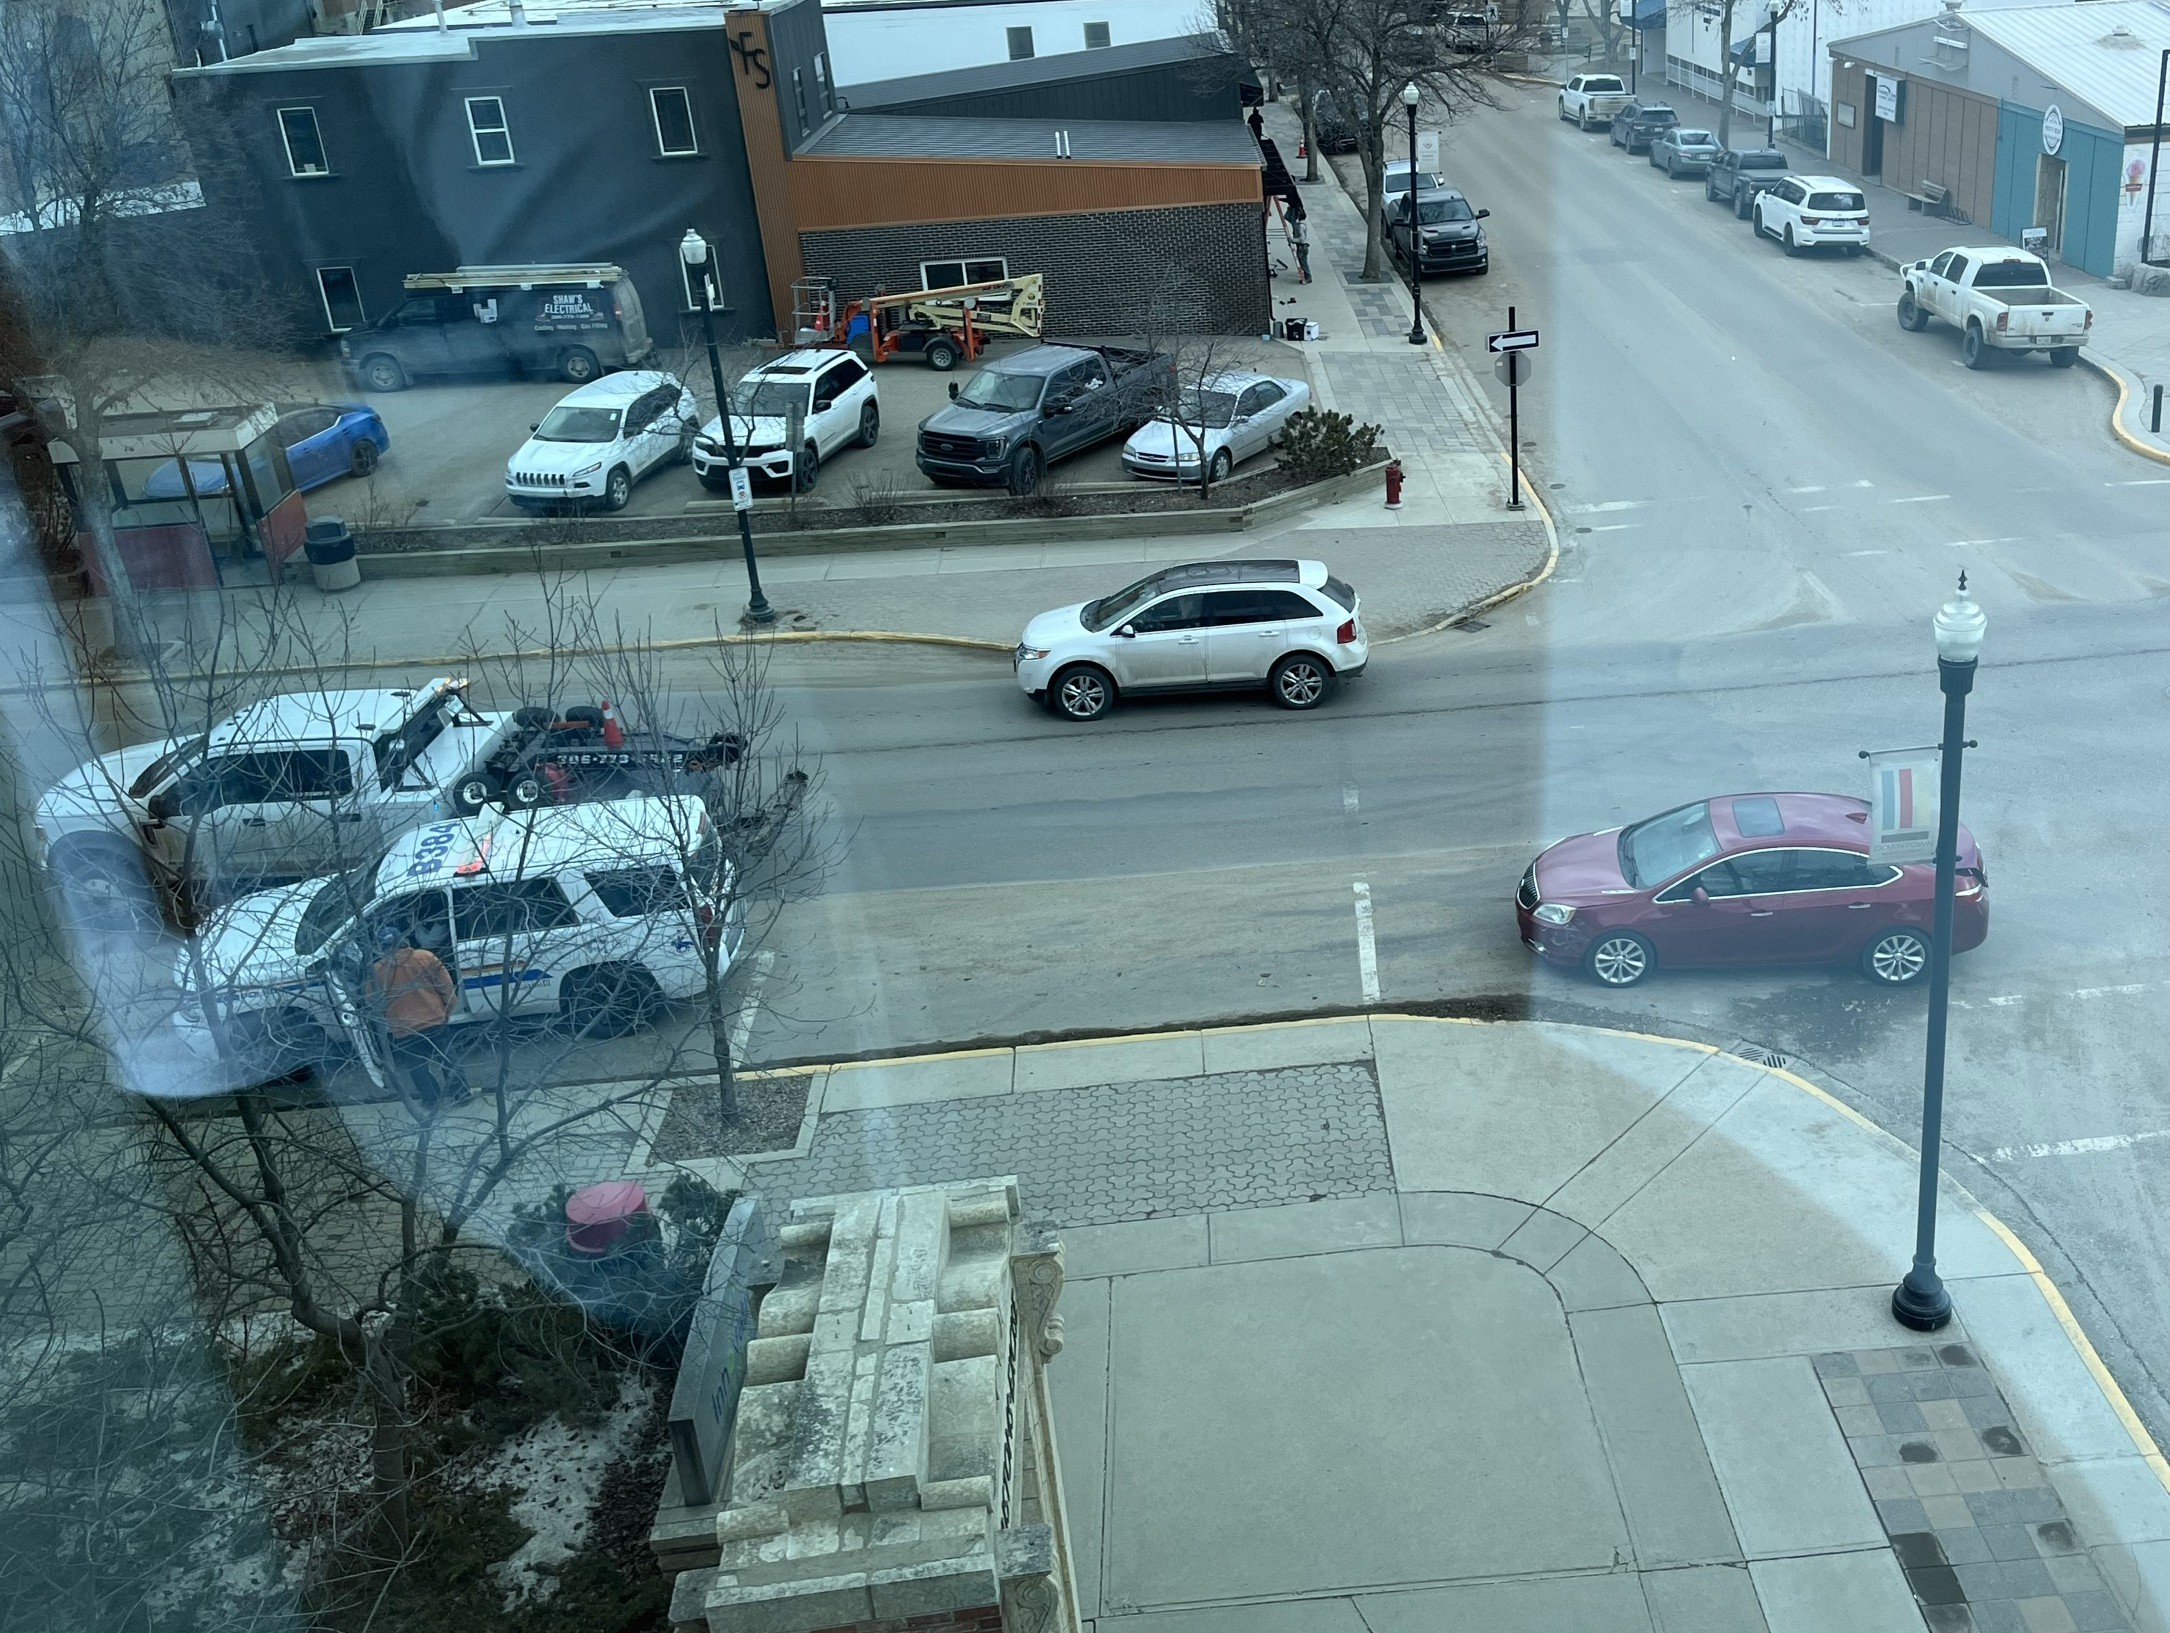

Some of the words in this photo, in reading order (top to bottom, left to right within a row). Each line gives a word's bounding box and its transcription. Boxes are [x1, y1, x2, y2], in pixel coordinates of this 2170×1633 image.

[553, 294, 583, 304] SHAW'S
[544, 303, 594, 314] ELECTRICAL
[407, 822, 461, 877] B384
[1874, 840, 1934, 852] DOWNTOWN
